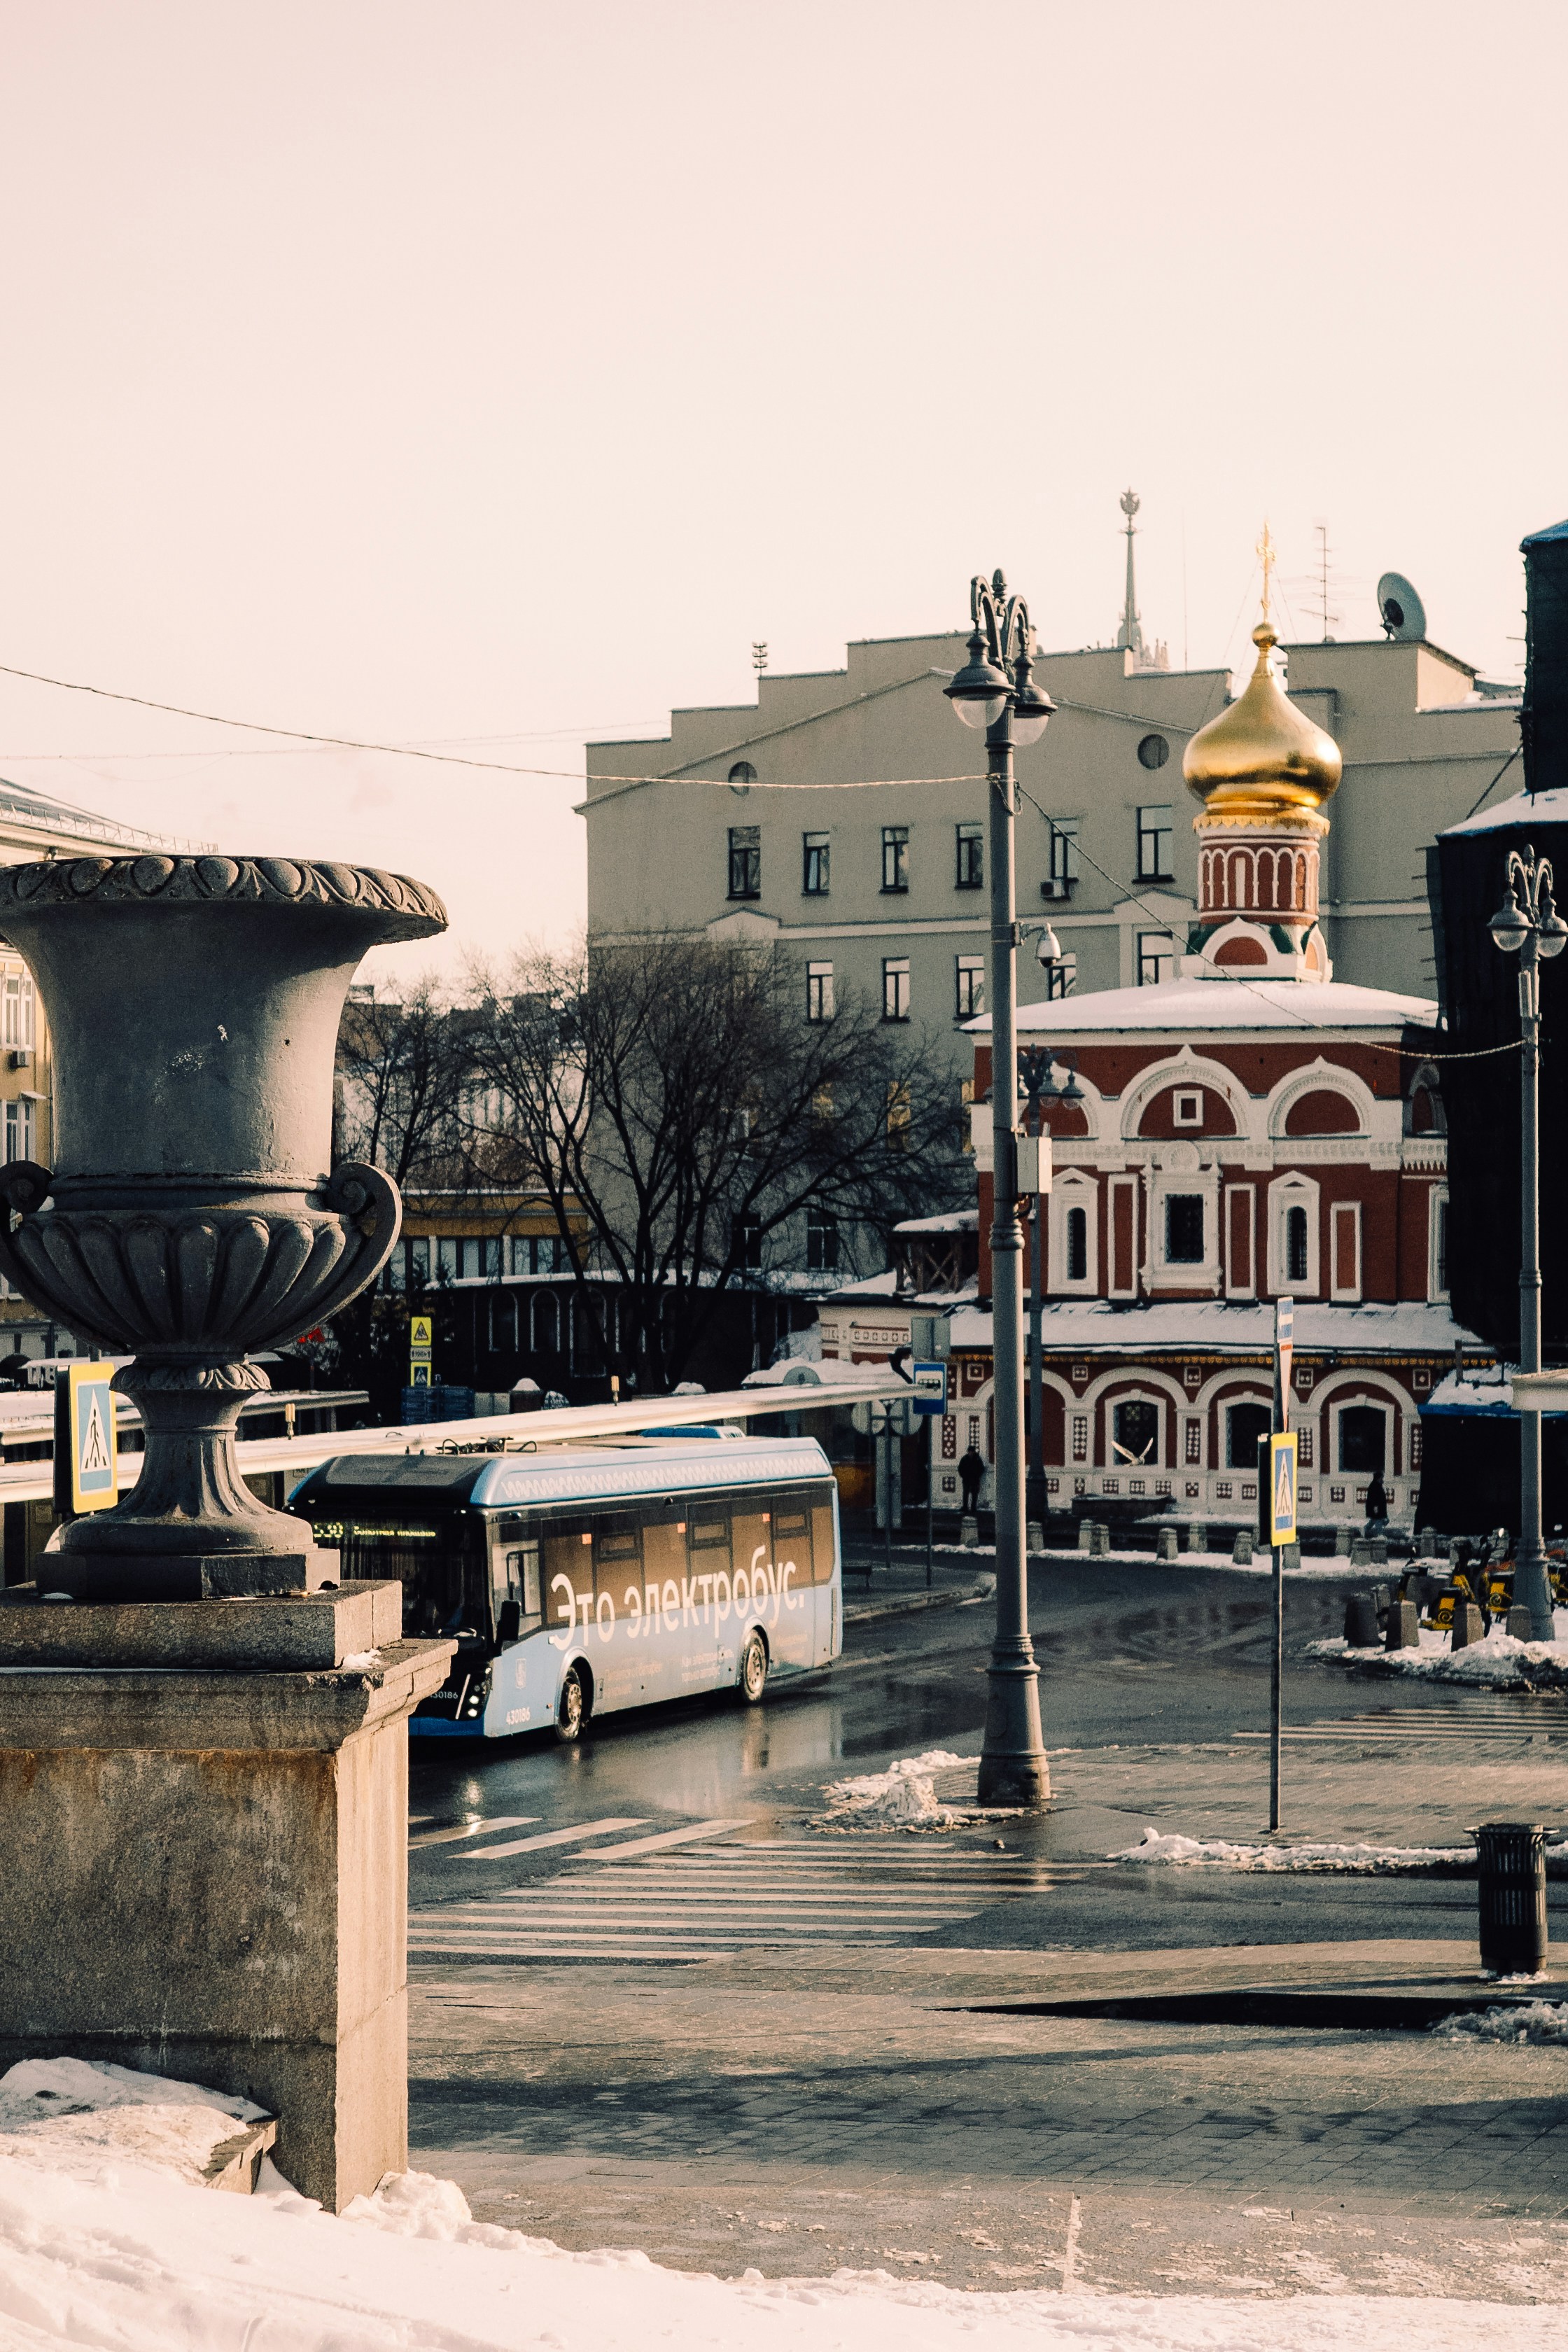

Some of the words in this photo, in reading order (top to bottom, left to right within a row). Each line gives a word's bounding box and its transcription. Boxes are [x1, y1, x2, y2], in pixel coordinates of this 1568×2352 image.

[550, 1573, 616, 1651] Это
[624, 1544, 805, 1639] электробус.
[505, 1707, 531, 1726] 430186
